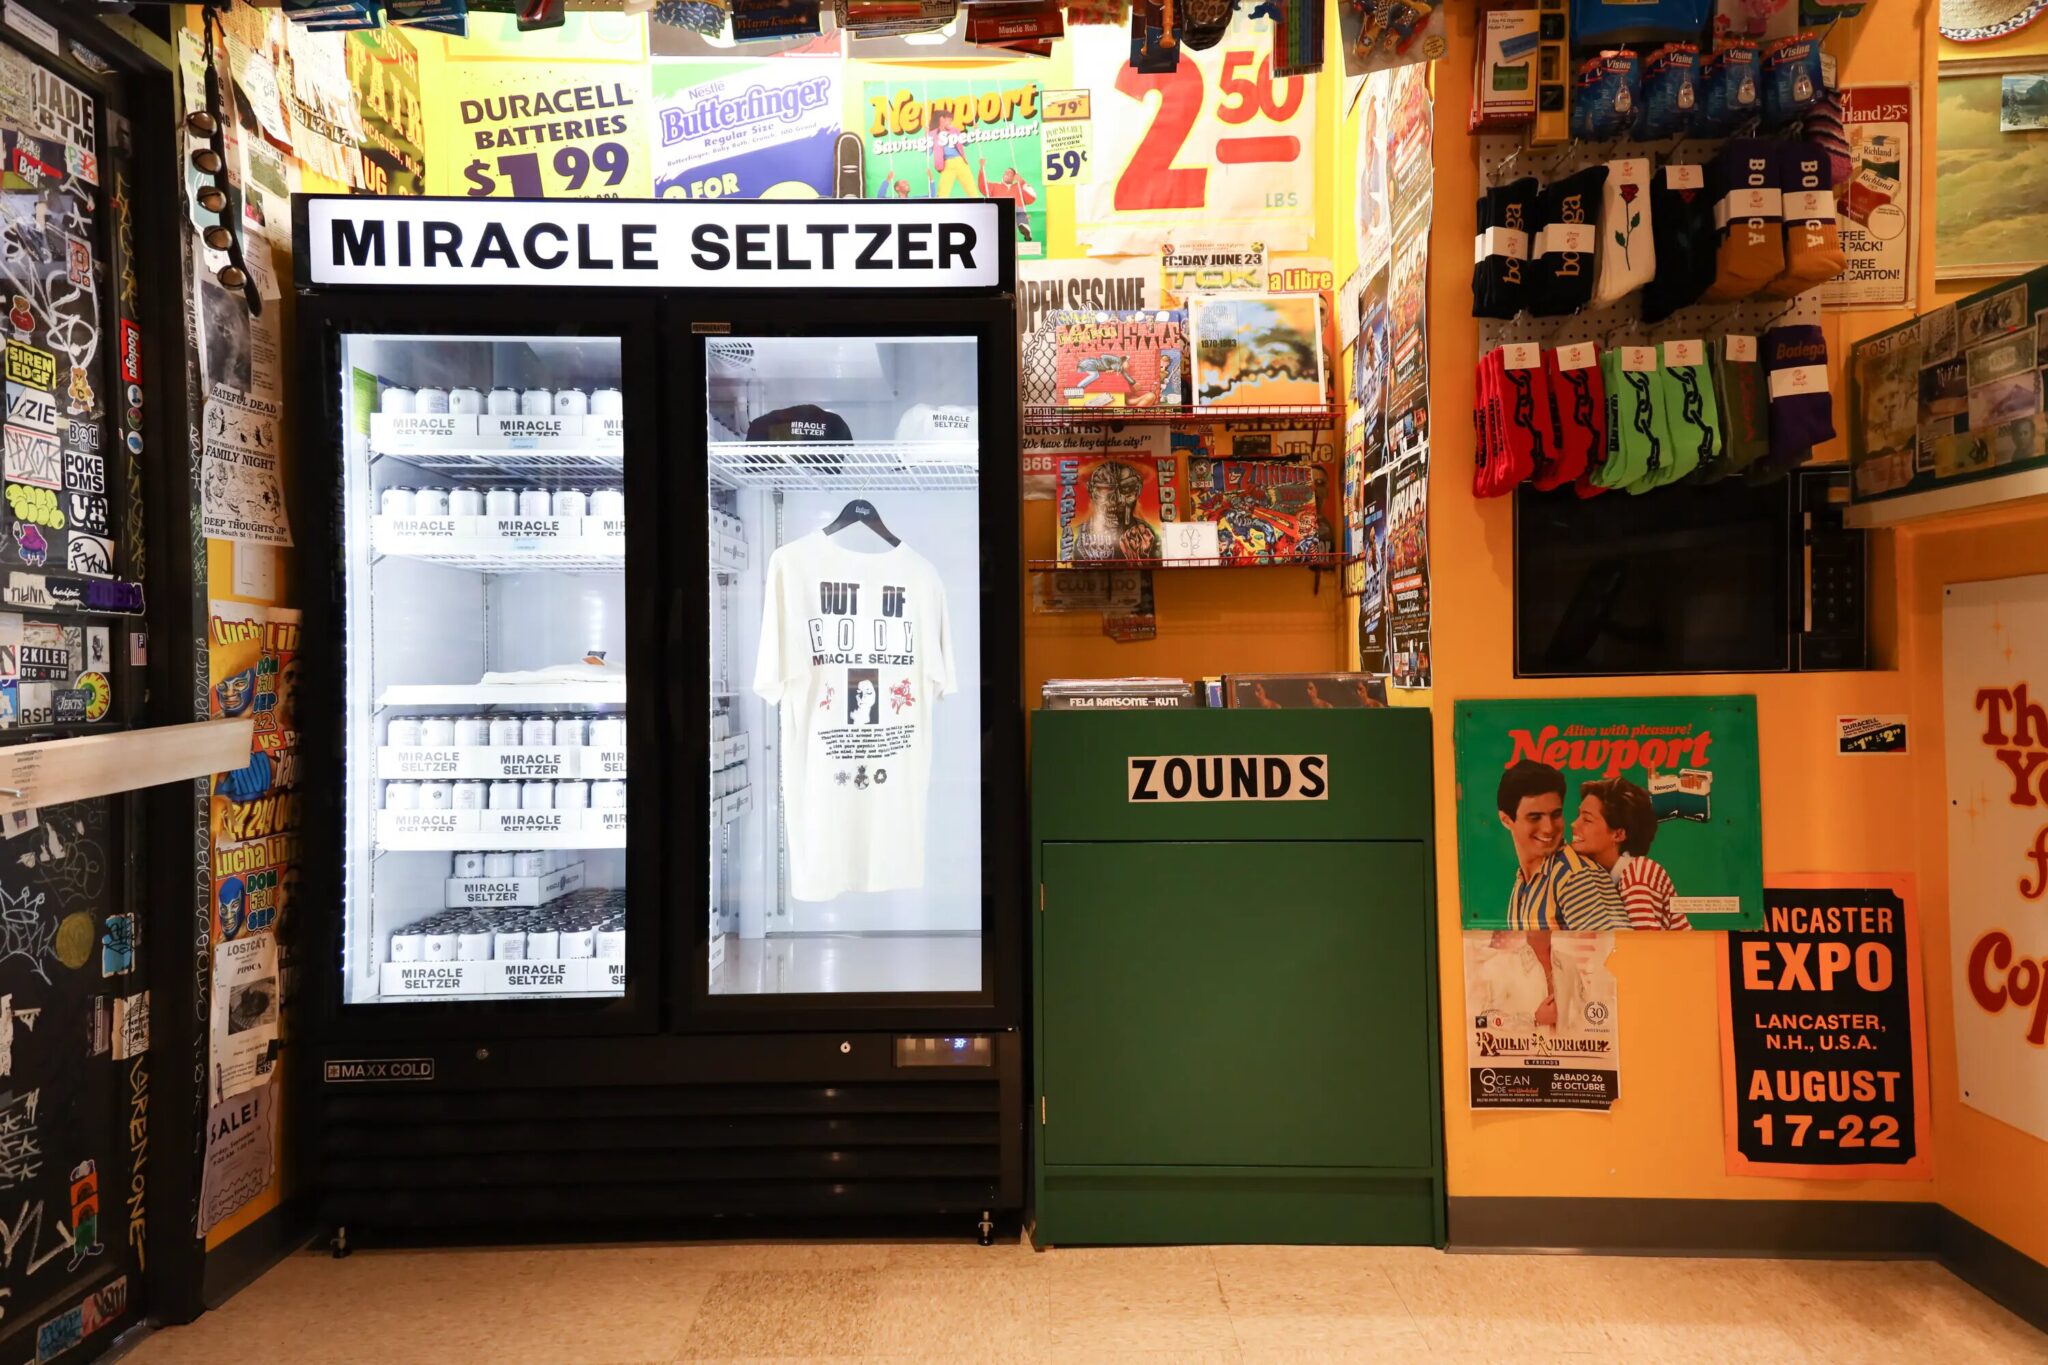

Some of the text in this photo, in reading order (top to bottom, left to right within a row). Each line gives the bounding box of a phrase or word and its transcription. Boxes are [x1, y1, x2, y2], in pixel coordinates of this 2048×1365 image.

[998, 26, 1022, 34] Muscle
[1729, 49, 1752, 60] Visine
[1780, 44, 1810, 58] Visine
[1607, 60, 1631, 70] Visine
[1670, 53, 1693, 64] Visine
[460, 83, 634, 125] DURACELL
[660, 76, 831, 147] Butterfinger
[474, 114, 627, 150] BATTERIES
[704, 123, 774, 147] Regular Size
[938, 120, 1040, 148] Spectacular!
[1046, 150, 1087, 181] 59¢
[691, 172, 740, 198] FOR
[1266, 193, 1297, 208] LBS
[331, 219, 978, 271] MIRACLE SELTZER
[1850, 241, 1883, 252] PACK!
[1162, 253, 1262, 266] FRIDAY JUNE 23
[1284, 268, 1333, 291] Libre
[1850, 270, 1900, 281] CARTON!
[1068, 277, 1145, 311] SESAME
[10, 346, 52, 371] SIREN
[127, 326, 140, 380] Bodega
[250, 398, 276, 413] DEAD
[393, 419, 455, 429] MIRACLE
[932, 414, 970, 422] MIRACLE
[934, 421, 969, 429] SELTZER
[500, 421, 561, 430] MIRACLE
[791, 421, 826, 430] MIRACLE
[791, 428, 825, 436] SELTZER
[1040, 438, 1062, 448] have
[1064, 437, 1077, 448] the
[1079, 436, 1095, 450] key
[1106, 437, 1120, 448] the
[65, 453, 103, 475] POKE
[205, 445, 276, 471] FAMILY NIGHT
[66, 471, 103, 492] DMS
[204, 517, 287, 535] DEEP THOUGHTS JP
[393, 521, 455, 530] MIRACLE
[498, 521, 559, 530] MIRACLE
[820, 581, 906, 618] OUT OF
[22, 647, 67, 665] 2KILER
[21, 668, 67, 679] OTC DFW
[1069, 697, 1094, 707] FELA
[22, 707, 53, 724] RSP
[1843, 717, 1878, 731] DURACELL
[1564, 723, 1692, 740] Alive with pleasure!
[399, 752, 460, 762] MIRACLE
[501, 754, 561, 764] MIRACLE
[1504, 725, 1712, 779] Newport
[401, 762, 457, 772] SELTZER
[504, 765, 558, 775] SELTZER
[1131, 756, 1326, 800] ZOUNDS
[396, 815, 457, 825] MIRACLE
[501, 815, 561, 825] MIRACLE
[216, 841, 265, 878] Lucha
[246, 868, 278, 894] DOM
[464, 883, 519, 893] MIRACLE
[467, 892, 517, 902] SELTZER
[247, 907, 277, 931] SEP
[237, 962, 262, 976] PIPOCA
[402, 968, 463, 978] MIRACLE
[505, 965, 565, 974] MIRACLE
[1742, 941, 1893, 992] EXPO
[405, 979, 460, 989] SELTZER
[508, 975, 563, 985] SELTZER
[1589, 1006, 1603, 1019] 30
[1755, 1014, 1887, 1033] LANCASTER,
[1476, 1032, 1529, 1056] RAULIN
[1766, 1034, 1878, 1053] N.H., U.S.A.
[341, 1061, 431, 1078] MAXX COLD
[1553, 1073, 1603, 1083] SABADO 26
[1551, 1082, 1606, 1092] DE OCTUBRE
[1749, 1069, 1901, 1103] AUGUST
[210, 1099, 259, 1146] SALE!
[1753, 1113, 1901, 1148] 17-22
